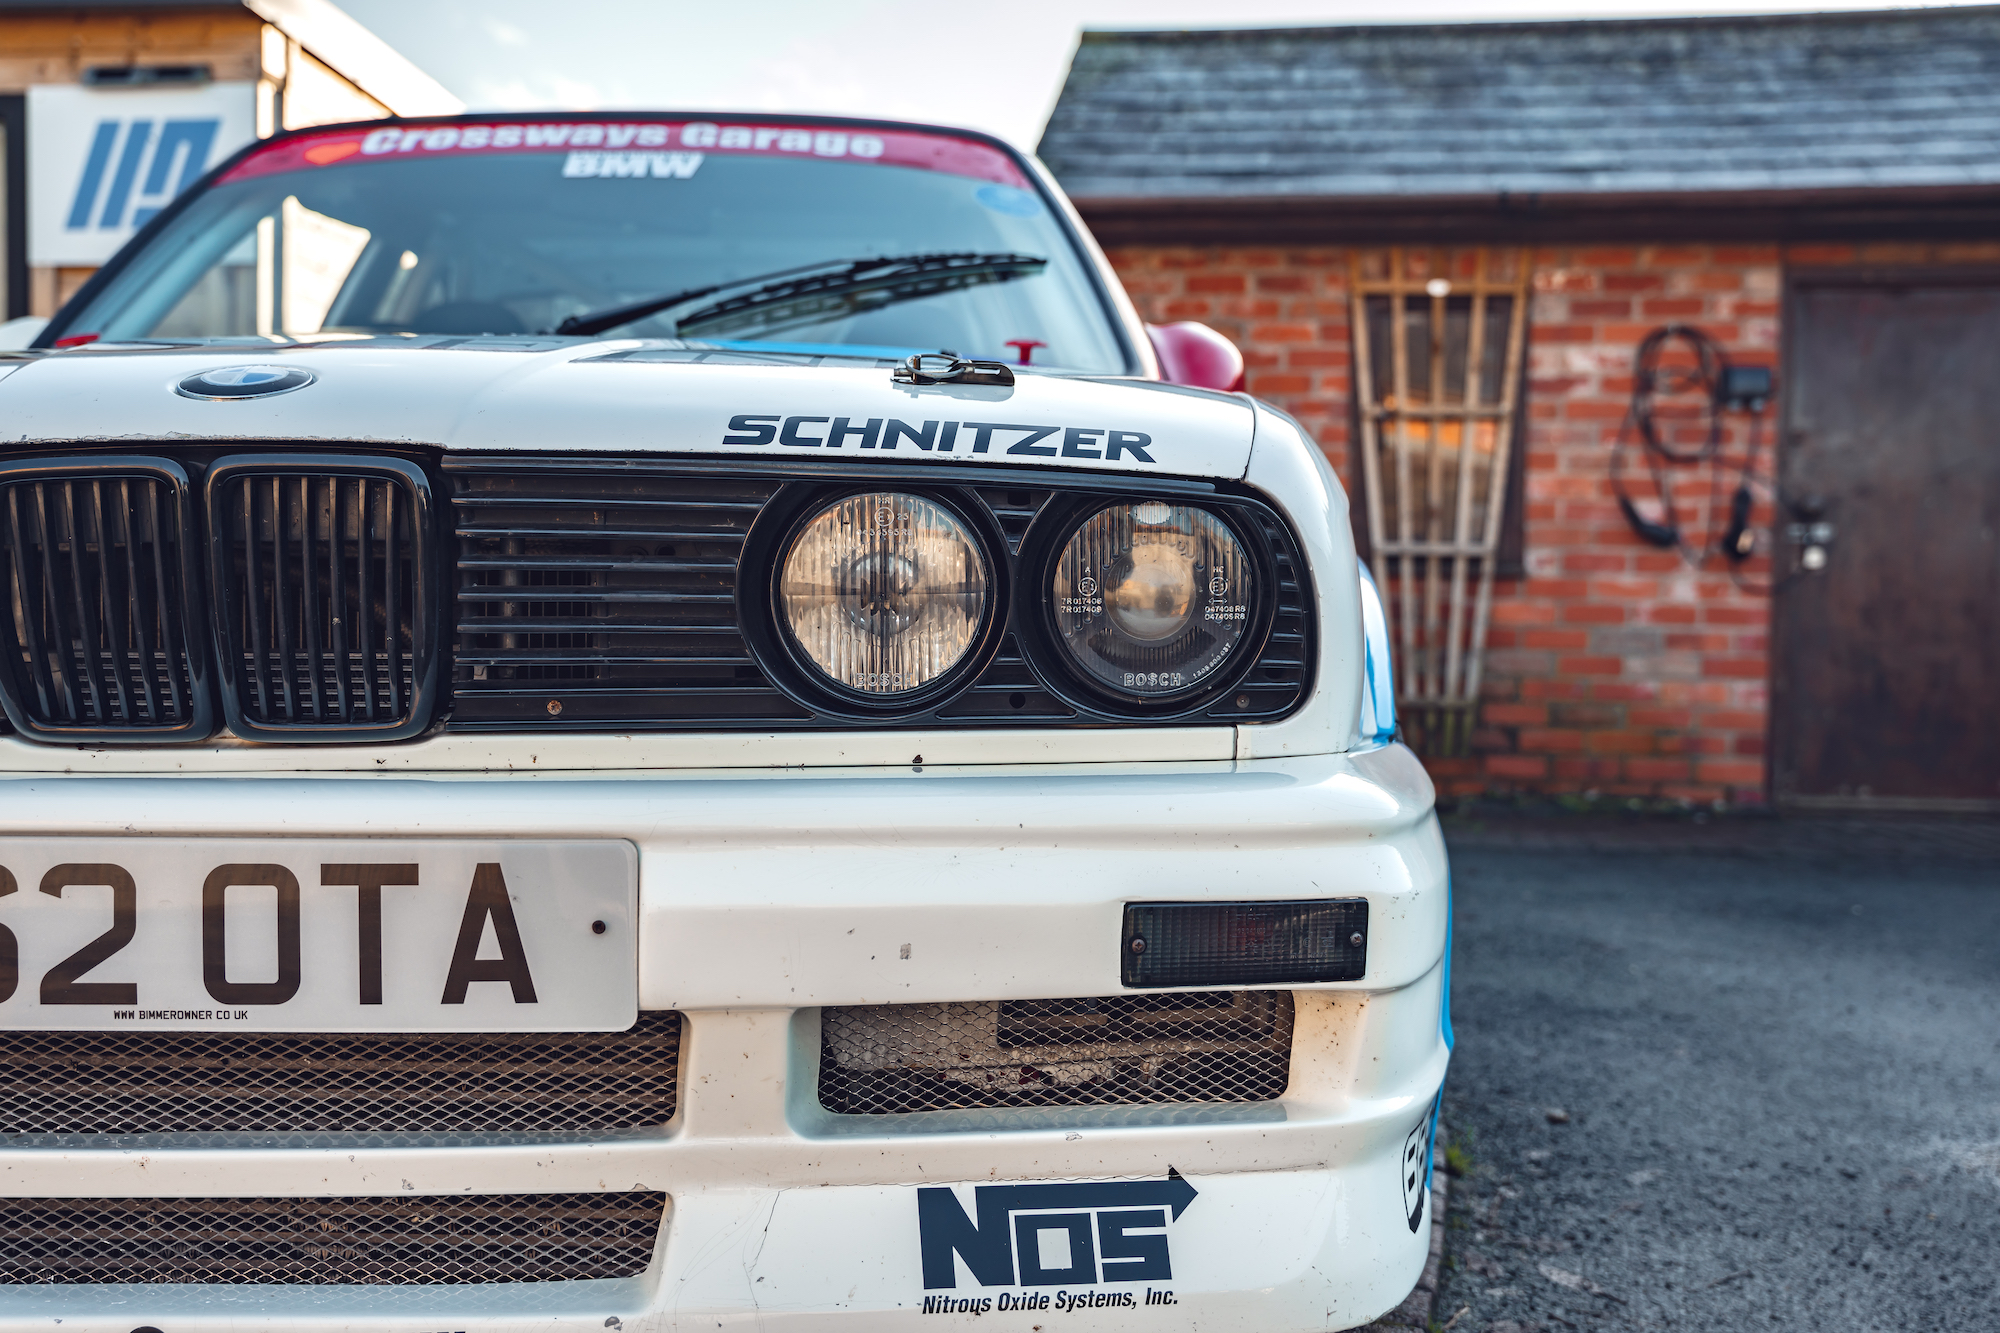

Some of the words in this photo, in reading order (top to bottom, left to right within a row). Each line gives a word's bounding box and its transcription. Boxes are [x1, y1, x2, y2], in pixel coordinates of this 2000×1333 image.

[360, 123, 669, 155] Crossways
[680, 121, 885, 157] Garage
[561, 149, 706, 180] BMW
[722, 414, 1157, 463] SCHNITZER
[856, 672, 914, 687] BOSCH
[1123, 672, 1181, 687] BOSCH
[203, 862, 539, 1006] OTA
[113, 1010, 135, 1020] WWW
[139, 1010, 213, 1020] BIMMEROWNER
[216, 1010, 230, 1020] CO
[234, 1010, 248, 1020] UK
[917, 1179, 1178, 1290] NOS
[922, 1295, 992, 1315] Nitrous
[997, 1291, 1050, 1312] Oxide
[1055, 1289, 1138, 1313] Systems,
[1144, 1287, 1179, 1306] Inc.
